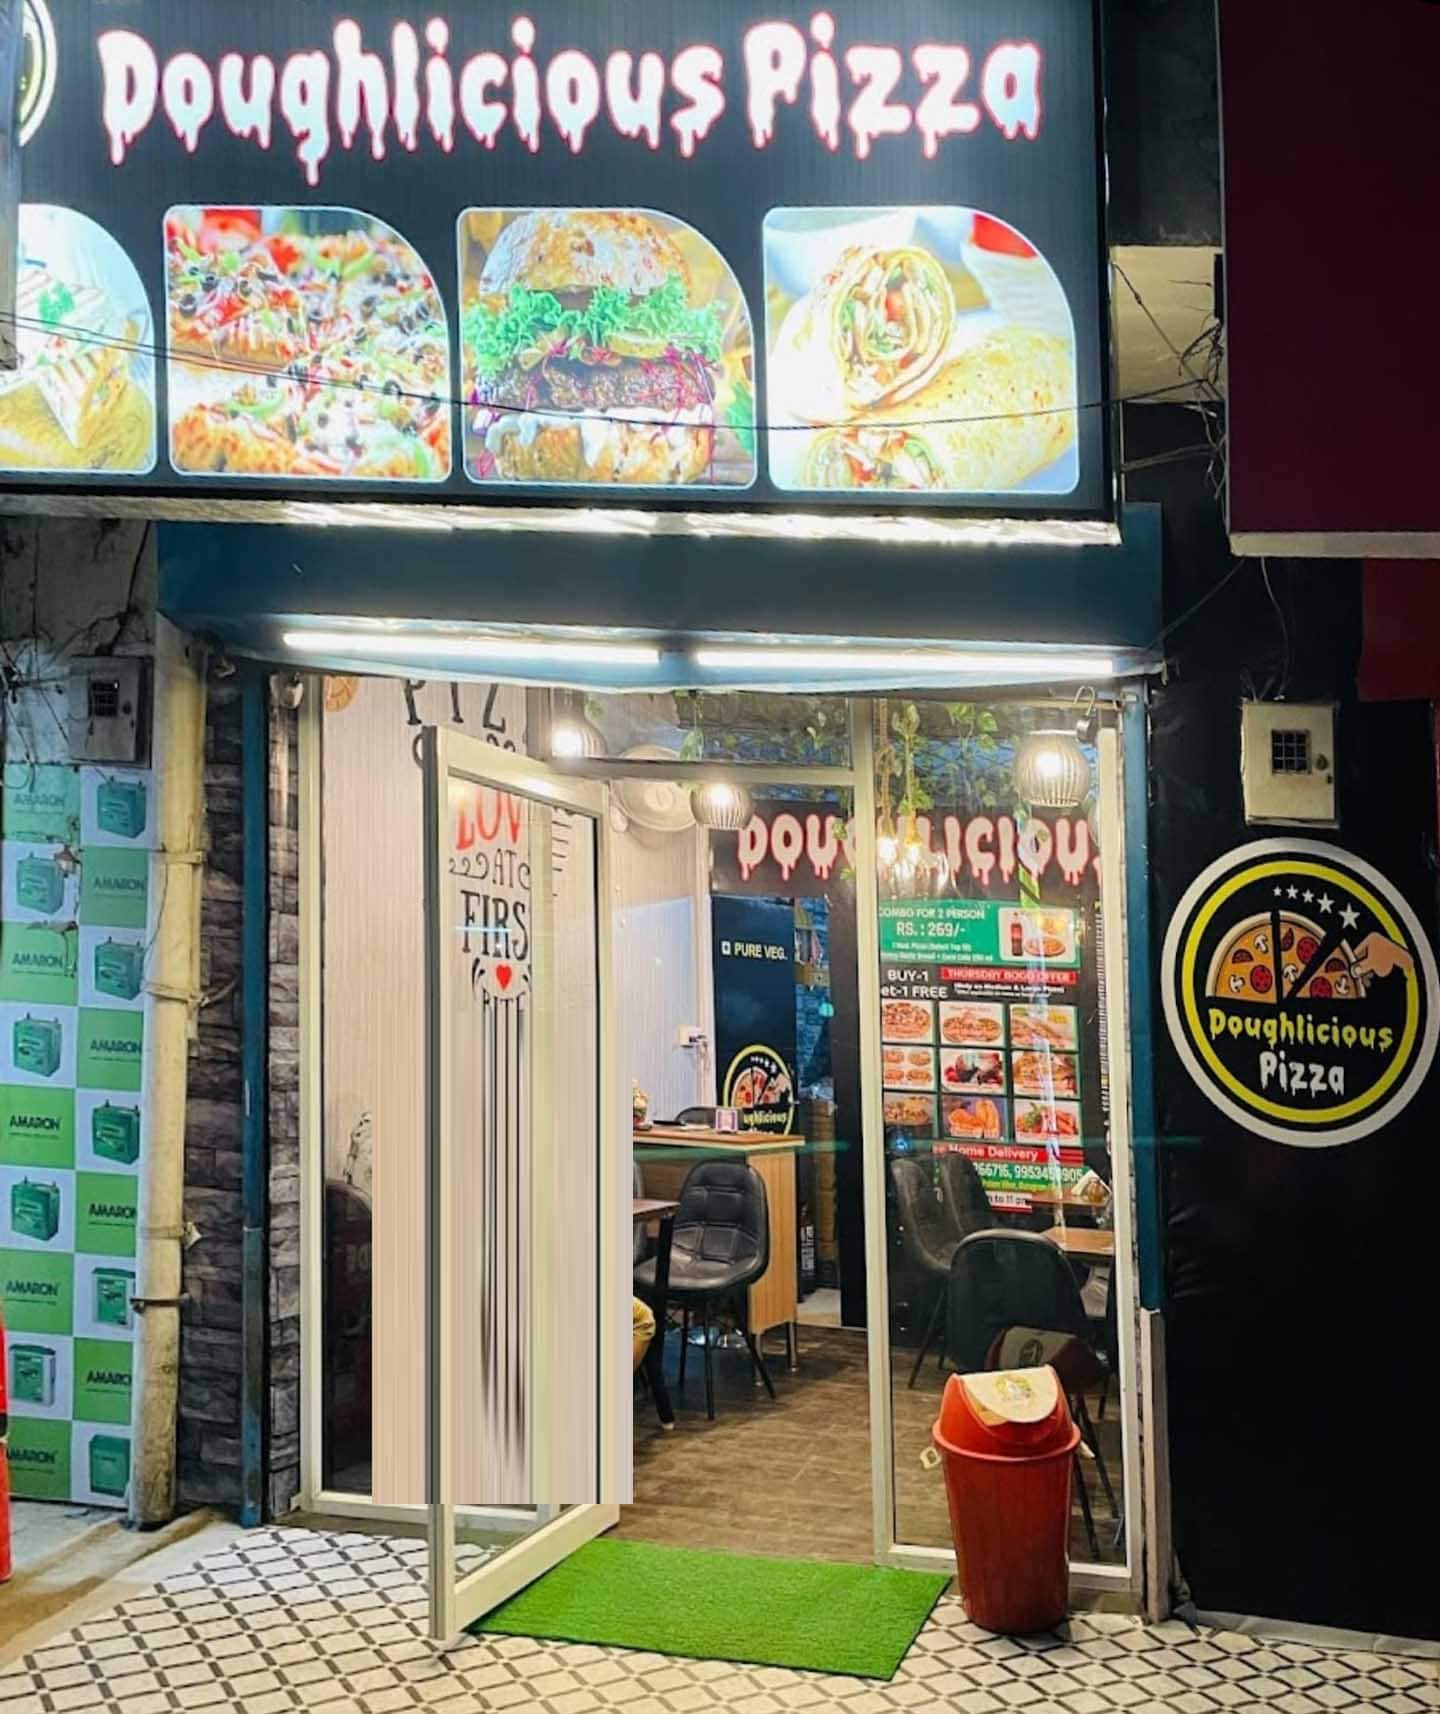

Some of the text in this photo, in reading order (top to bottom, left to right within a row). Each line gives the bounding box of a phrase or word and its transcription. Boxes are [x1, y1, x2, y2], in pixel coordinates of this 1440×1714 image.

[98, 12, 1042, 186] Doughlicious Pizza
[93, 876, 145, 890] AMARON
[946, 908, 985, 921] PERSON
[734, 943, 762, 958] PURE
[12, 953, 63, 968] AMARON
[887, 969, 929, 981] BUY-1
[912, 986, 948, 998] FREE
[1207, 1008, 1393, 1052] Doughlicious
[90, 1039, 142, 1053] AMARON
[1259, 1050, 1345, 1098] Pizza
[9, 1115, 61, 1131] AMARON
[988, 1146, 1039, 1162] Delivery
[6, 1279, 58, 1296] AMARON
